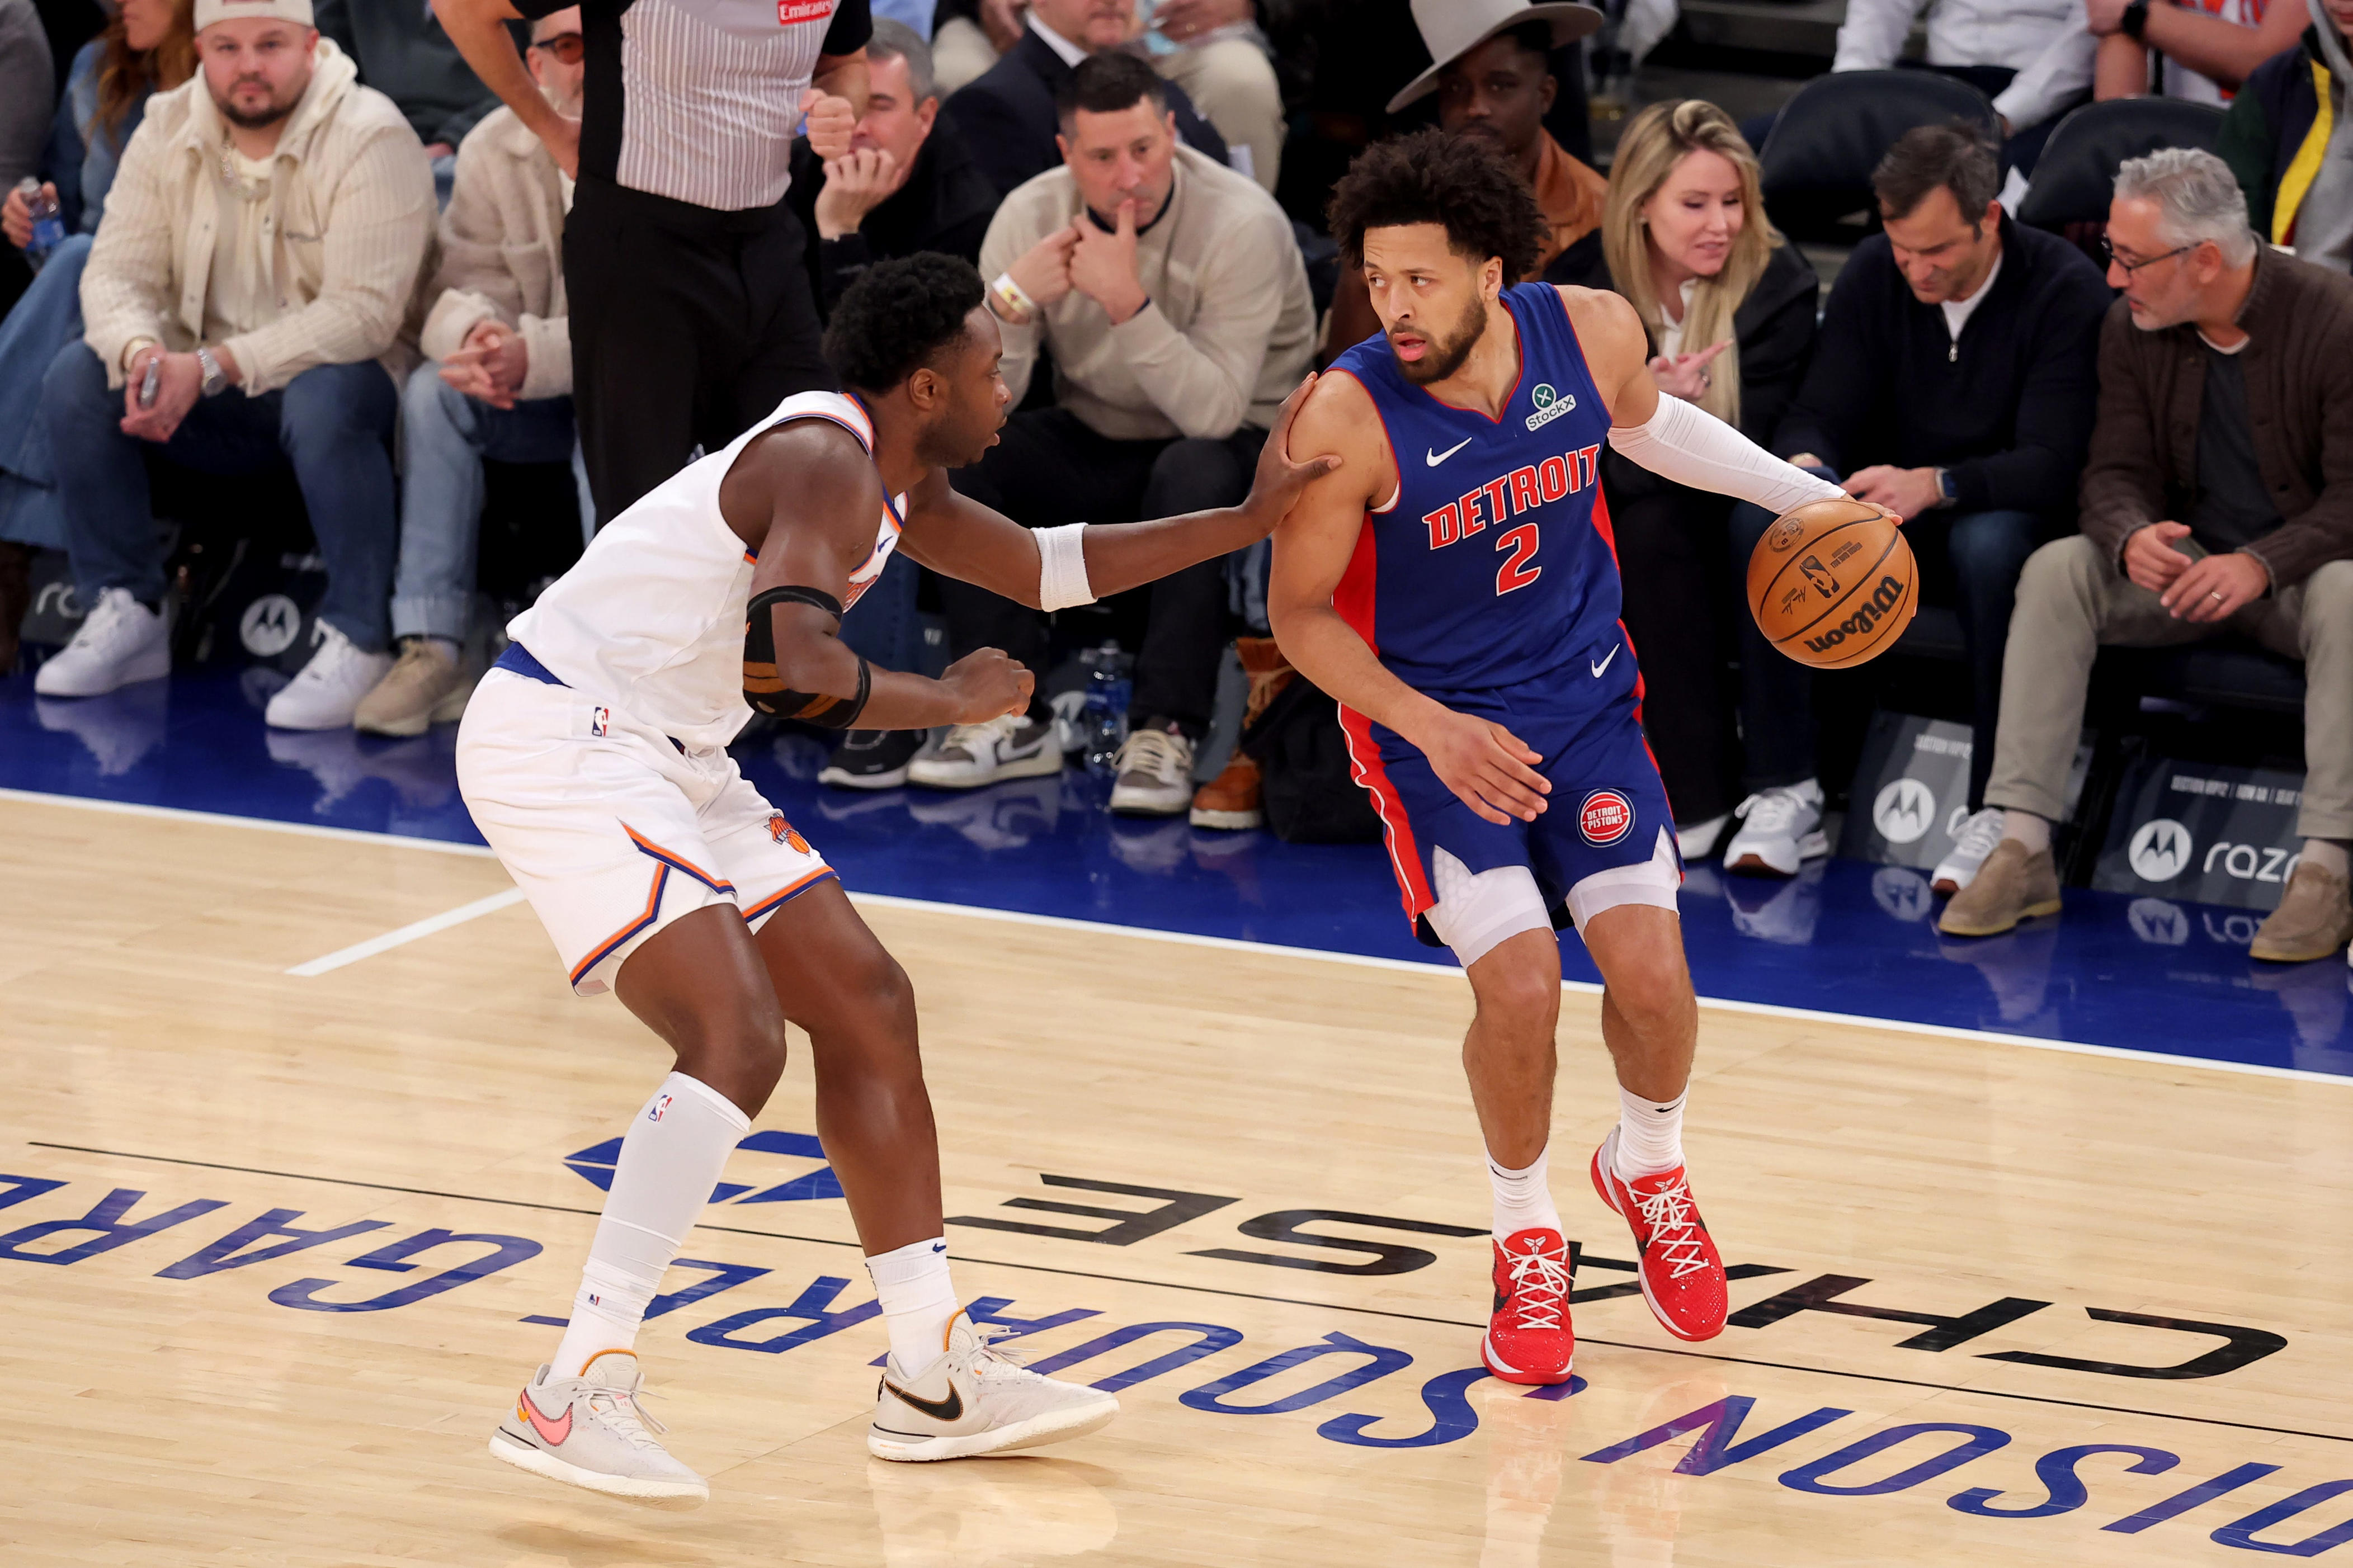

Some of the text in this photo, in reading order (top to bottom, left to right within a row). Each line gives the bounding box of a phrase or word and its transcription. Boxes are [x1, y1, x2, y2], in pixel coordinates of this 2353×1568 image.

[1528, 396, 1574, 428] StockX
[1422, 443, 1600, 550] DETROIT
[1496, 522, 1542, 597] 2
[1804, 575, 1904, 653] Wilson
[1586, 805, 1621, 820] DETROIT
[1587, 815, 1623, 830] PISTONS
[943, 1173, 2288, 1380] CHASE
